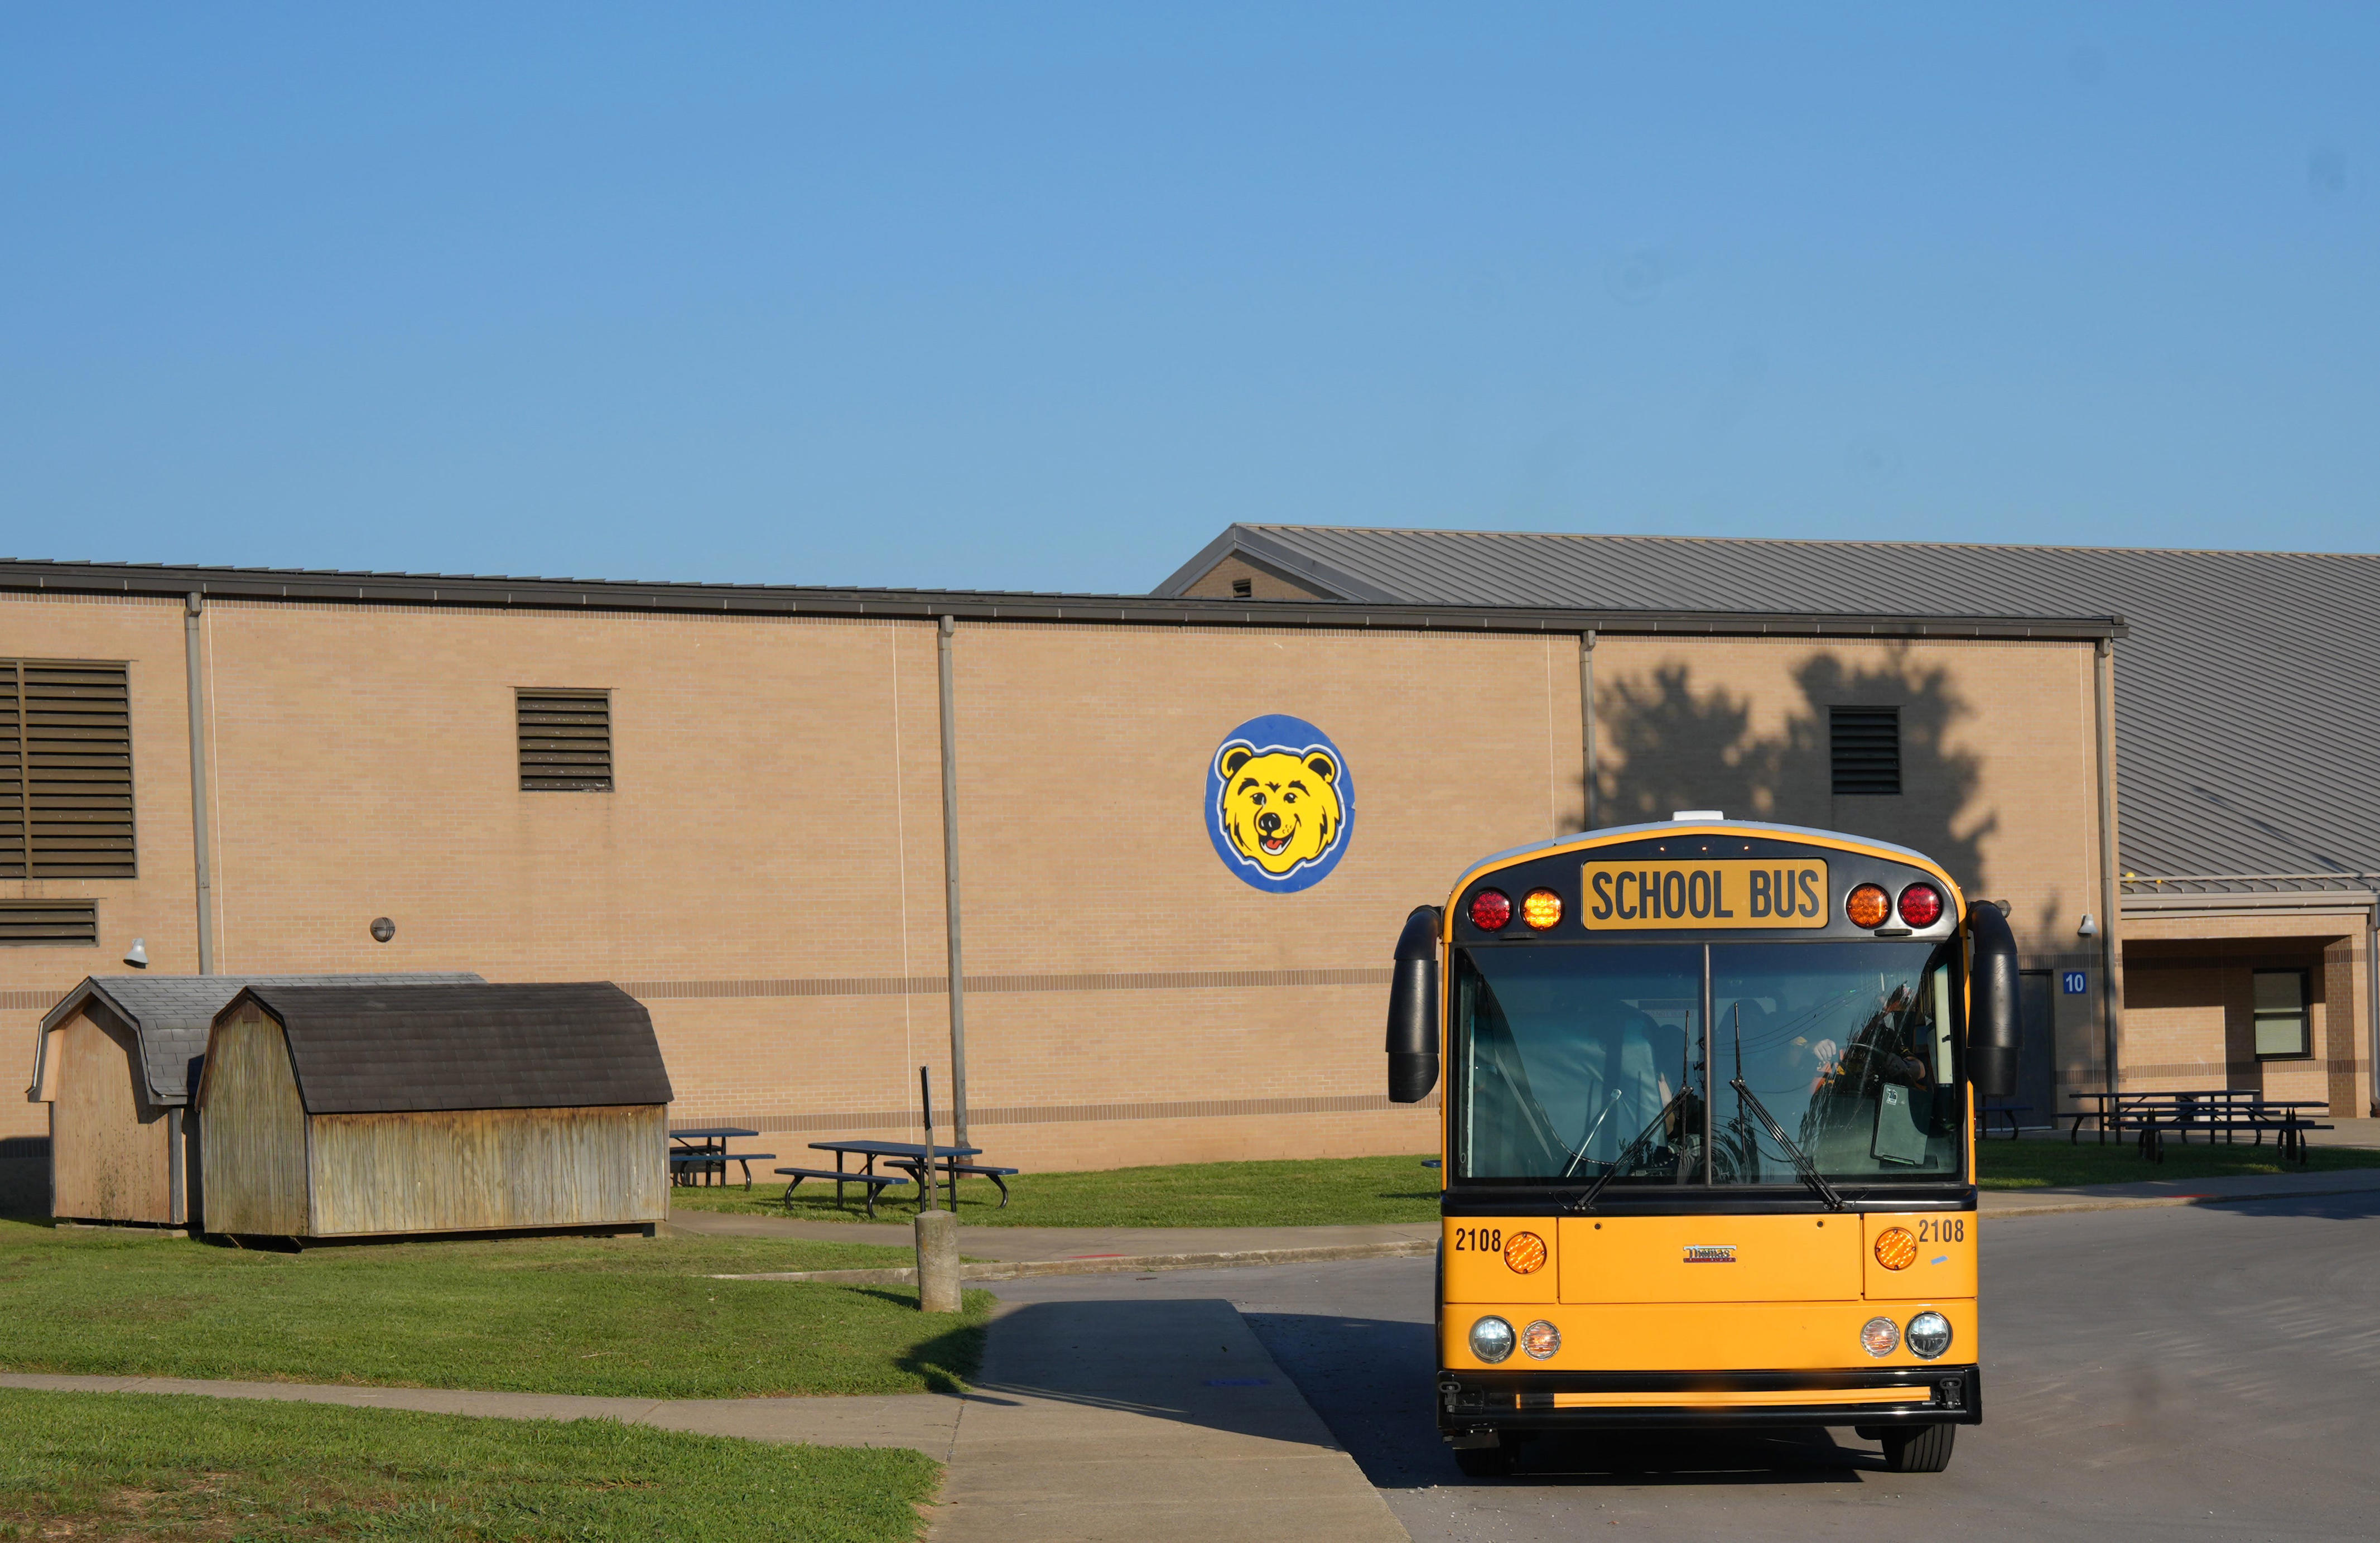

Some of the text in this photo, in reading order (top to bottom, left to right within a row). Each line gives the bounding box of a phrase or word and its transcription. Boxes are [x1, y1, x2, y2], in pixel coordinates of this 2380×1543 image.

[1592, 869, 1819, 920] SCHOOL BUS
[2065, 974, 2084, 992] 10
[1456, 1228, 1501, 1252] 2108
[1919, 1219, 1964, 1242] 2108
